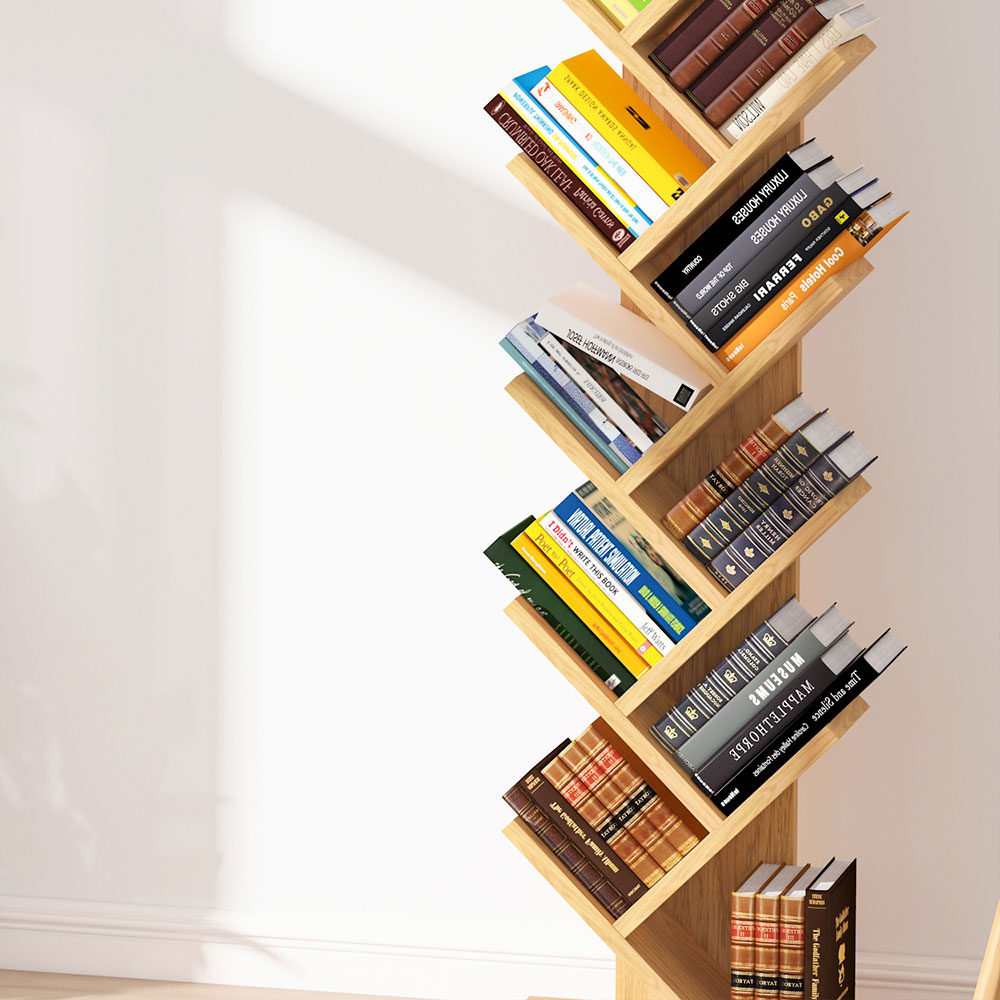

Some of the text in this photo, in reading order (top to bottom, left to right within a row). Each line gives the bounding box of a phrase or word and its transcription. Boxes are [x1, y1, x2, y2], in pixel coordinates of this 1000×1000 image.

[535, 533, 552, 554] Poet
[558, 558, 575, 579] Poet
[566, 508, 595, 540] VIRTUAL
[585, 526, 615, 560] PATIENT
[603, 546, 642, 586] SIMULATION
[552, 524, 574, 549] Didn't
[573, 545, 591, 564] WRITE
[588, 561, 604, 579] THIS
[601, 576, 619, 596] BOOK
[639, 622, 653, 637] Jeff
[650, 633, 667, 652] Watts
[812, 928, 820, 942] The
[812, 942, 821, 977] Godfather
